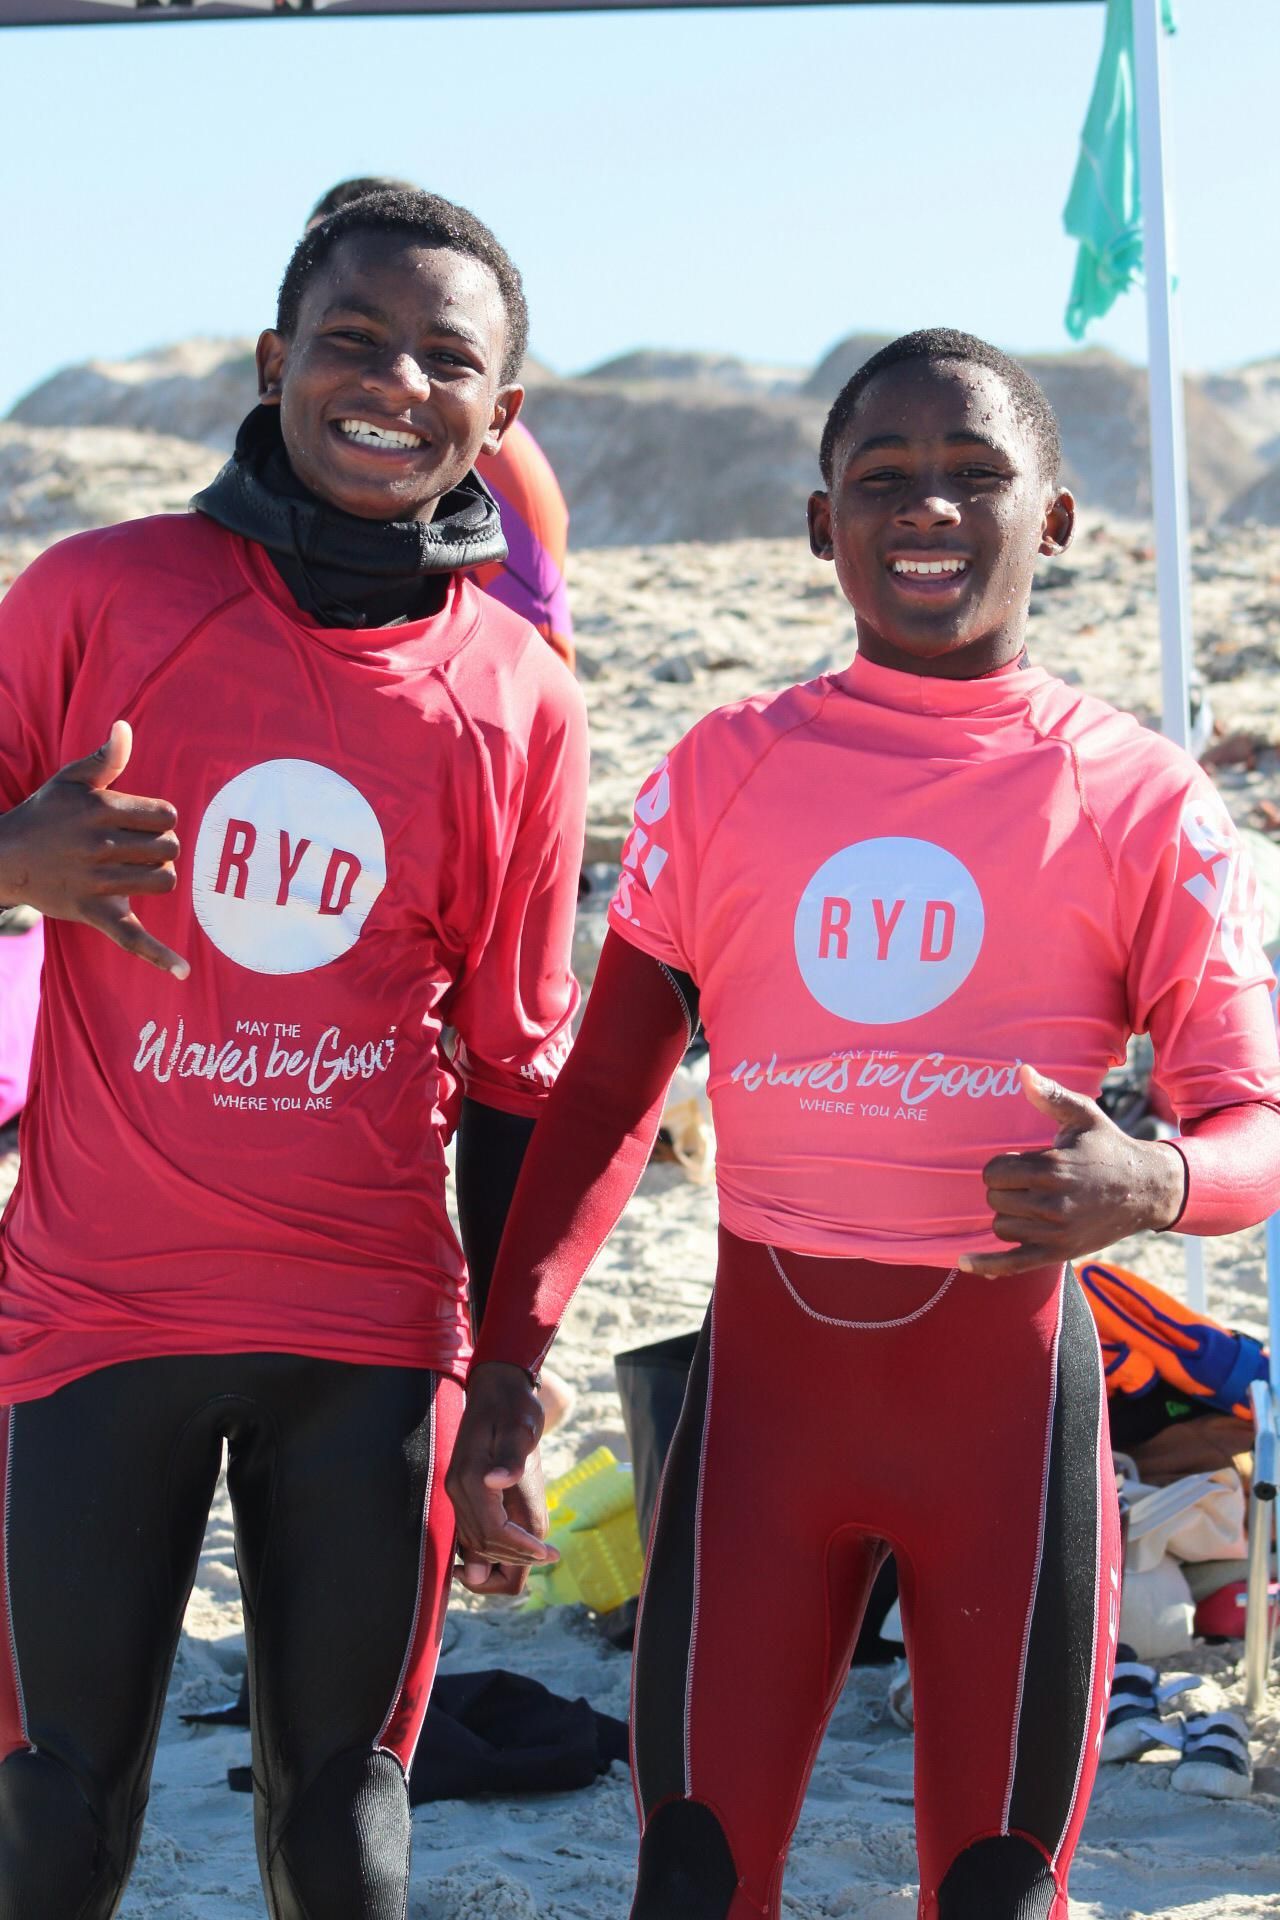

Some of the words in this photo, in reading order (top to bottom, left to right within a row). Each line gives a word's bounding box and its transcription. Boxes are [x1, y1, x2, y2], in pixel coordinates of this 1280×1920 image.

[214, 818, 362, 915] RYD
[817, 896, 956, 962] RYD
[133, 1014, 258, 1087] Waves
[264, 1037, 310, 1078] be
[236, 1020, 269, 1037] MAY
[273, 1023, 301, 1038] THE
[213, 1093, 268, 1111] WHERE
[271, 1097, 301, 1112] YOU
[304, 1096, 333, 1111] ARE
[856, 1057, 905, 1087] be
[901, 1052, 1023, 1105] Good
[799, 1098, 855, 1115] WHERE
[860, 1103, 889, 1117] YOU
[894, 1107, 928, 1121] ARE
